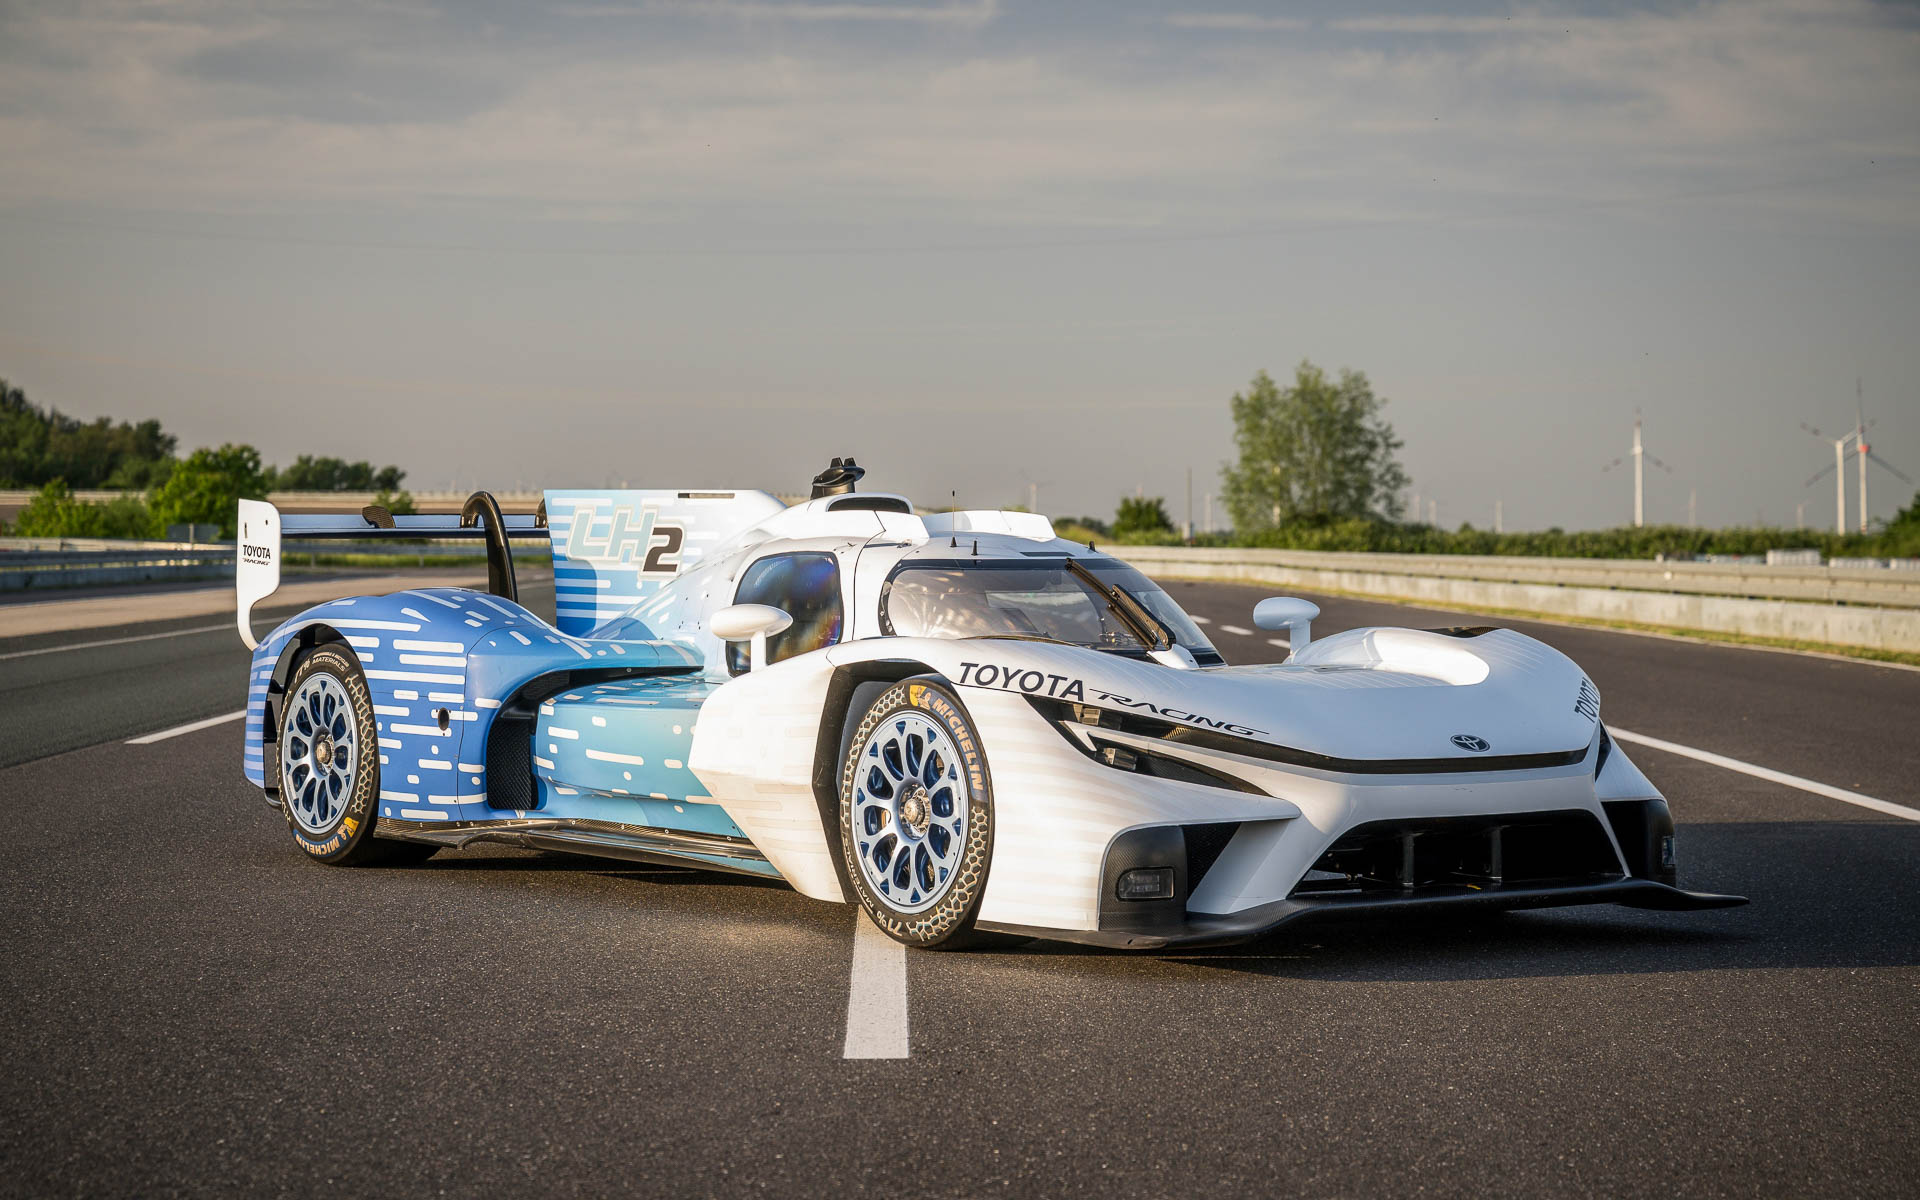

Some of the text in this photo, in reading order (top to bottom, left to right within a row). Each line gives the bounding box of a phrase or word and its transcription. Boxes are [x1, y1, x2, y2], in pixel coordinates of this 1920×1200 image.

[242, 544, 271, 559] TOYOTA
[568, 506, 684, 574] LH2
[242, 557, 271, 566] RACING
[312, 656, 346, 672] MATERIALS
[959, 662, 1270, 736] TOYOTA RACING
[932, 697, 984, 792] MICHELIN
[295, 835, 340, 856] MICHELIN
[876, 910, 903, 937] 71%
